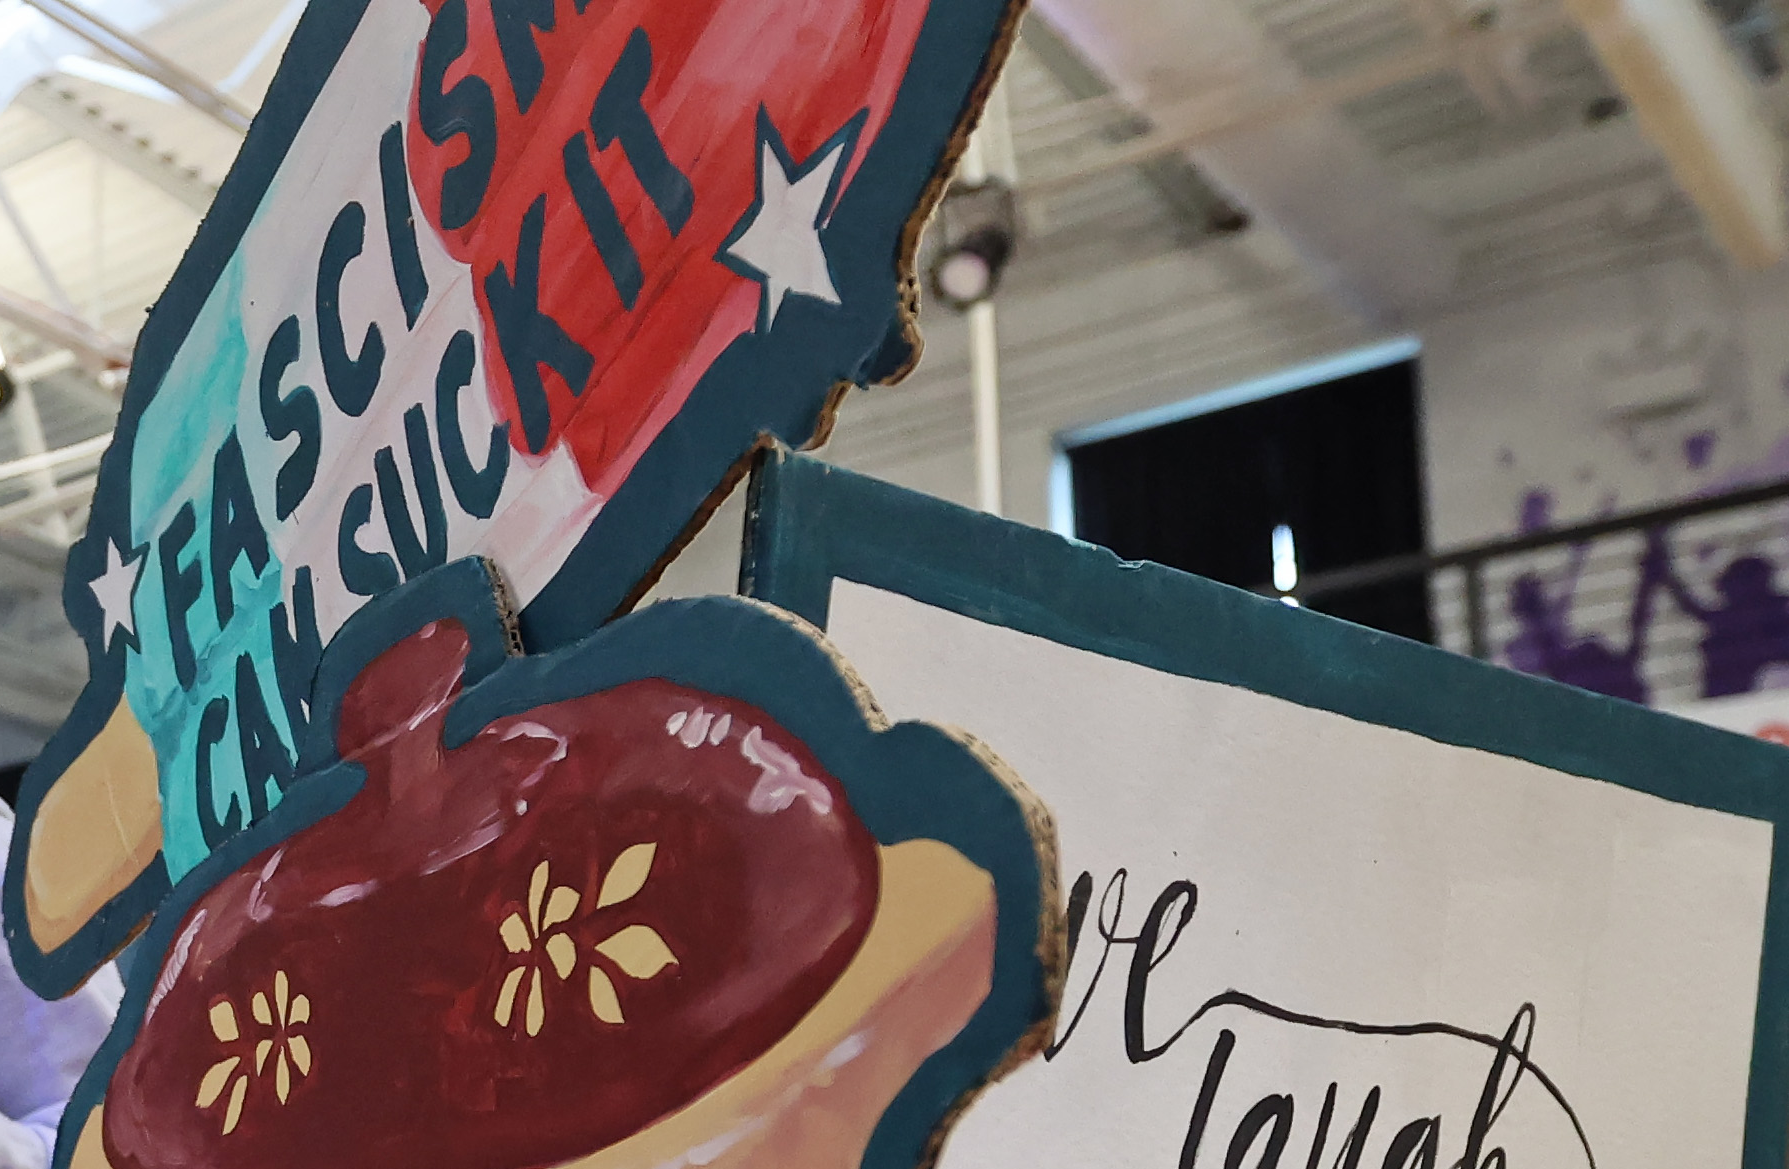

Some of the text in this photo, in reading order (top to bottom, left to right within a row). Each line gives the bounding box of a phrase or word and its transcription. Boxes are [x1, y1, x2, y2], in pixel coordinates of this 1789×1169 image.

[339, 193, 595, 597] SUCK
[561, 25, 695, 310] IT
[1045, 867, 1199, 1065] ve
